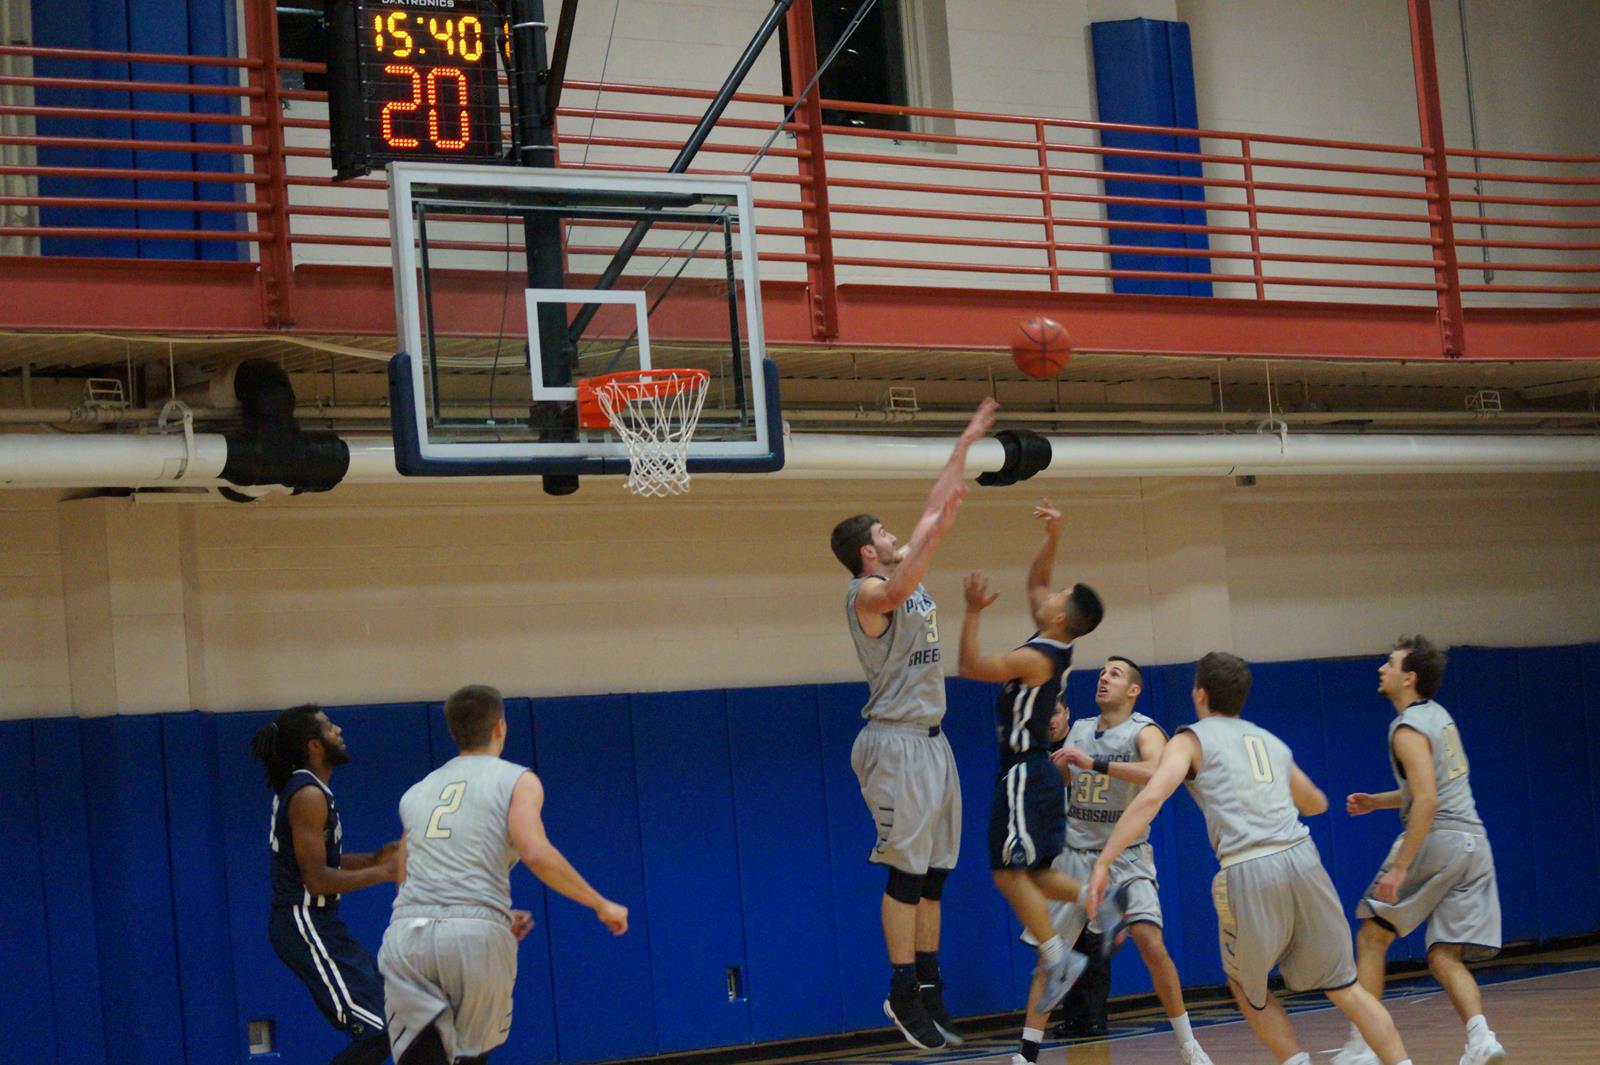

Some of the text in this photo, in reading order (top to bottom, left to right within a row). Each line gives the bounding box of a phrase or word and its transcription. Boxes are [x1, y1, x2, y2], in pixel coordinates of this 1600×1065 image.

[374, 11, 483, 61] 15:40
[382, 65, 469, 149] 20
[1242, 734, 1274, 784] 0
[424, 780, 468, 839] 2
[1076, 771, 1110, 806] 32
